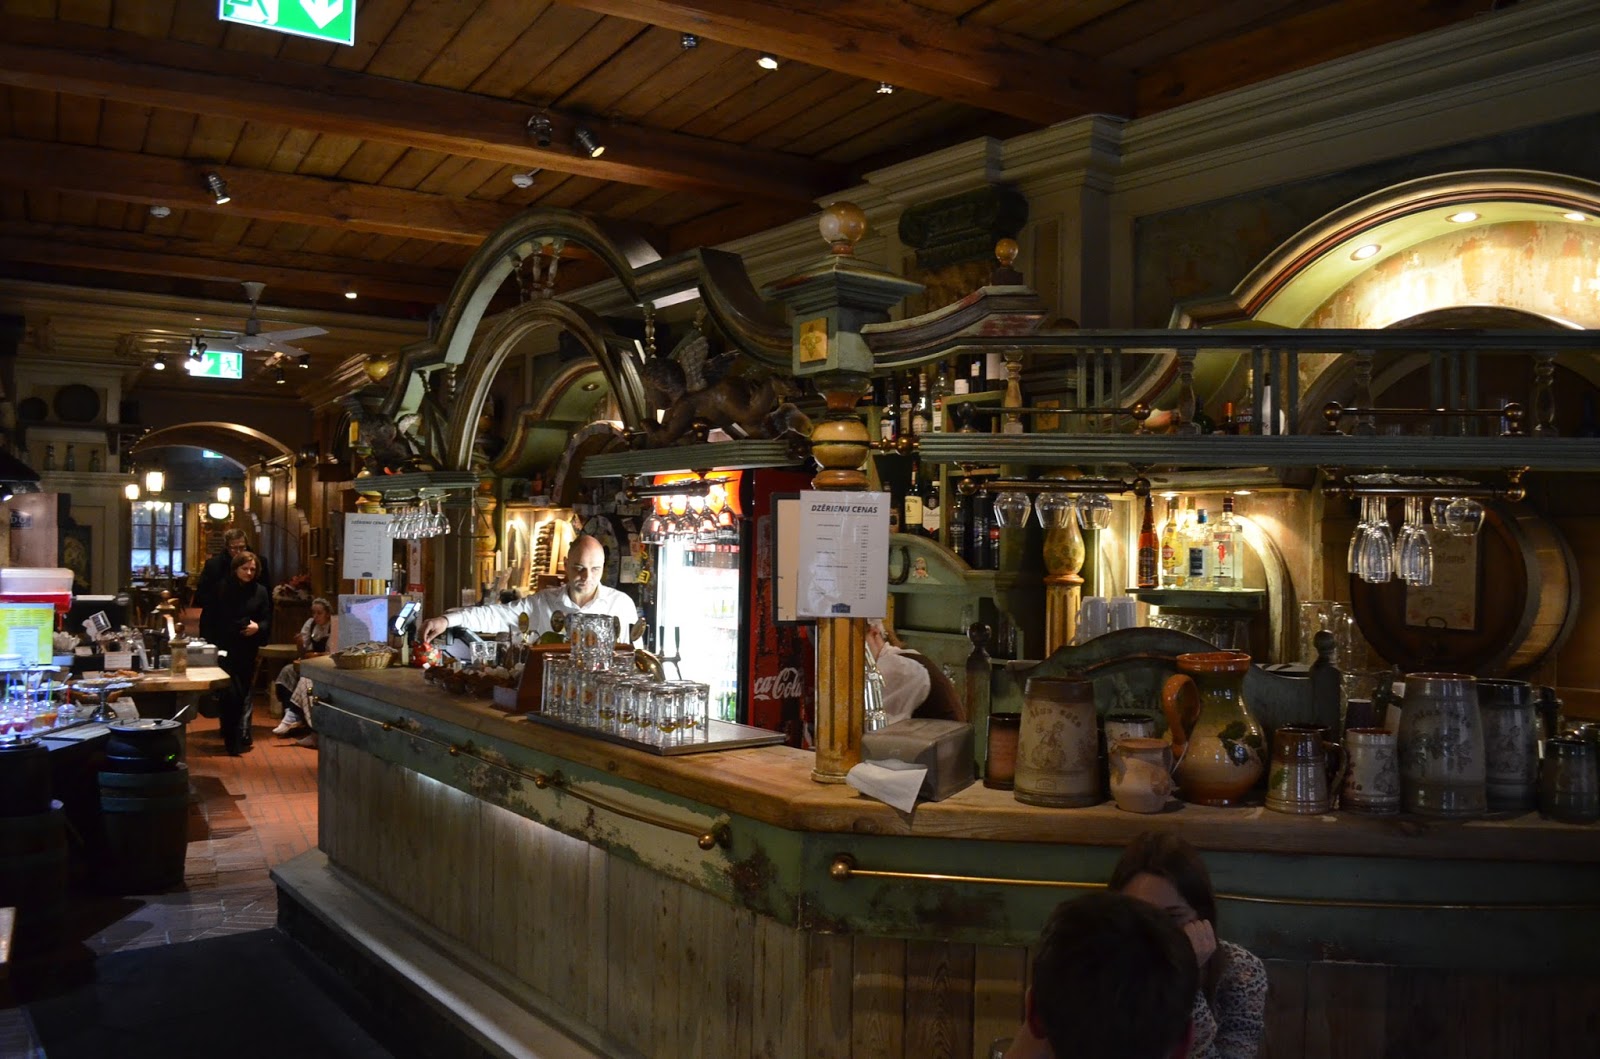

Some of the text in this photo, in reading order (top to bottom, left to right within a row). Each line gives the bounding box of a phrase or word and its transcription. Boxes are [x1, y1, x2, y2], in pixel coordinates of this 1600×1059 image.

[811, 503, 878, 514] DZĒRIENU CENAS
[754, 667, 802, 700] ca-Cola
